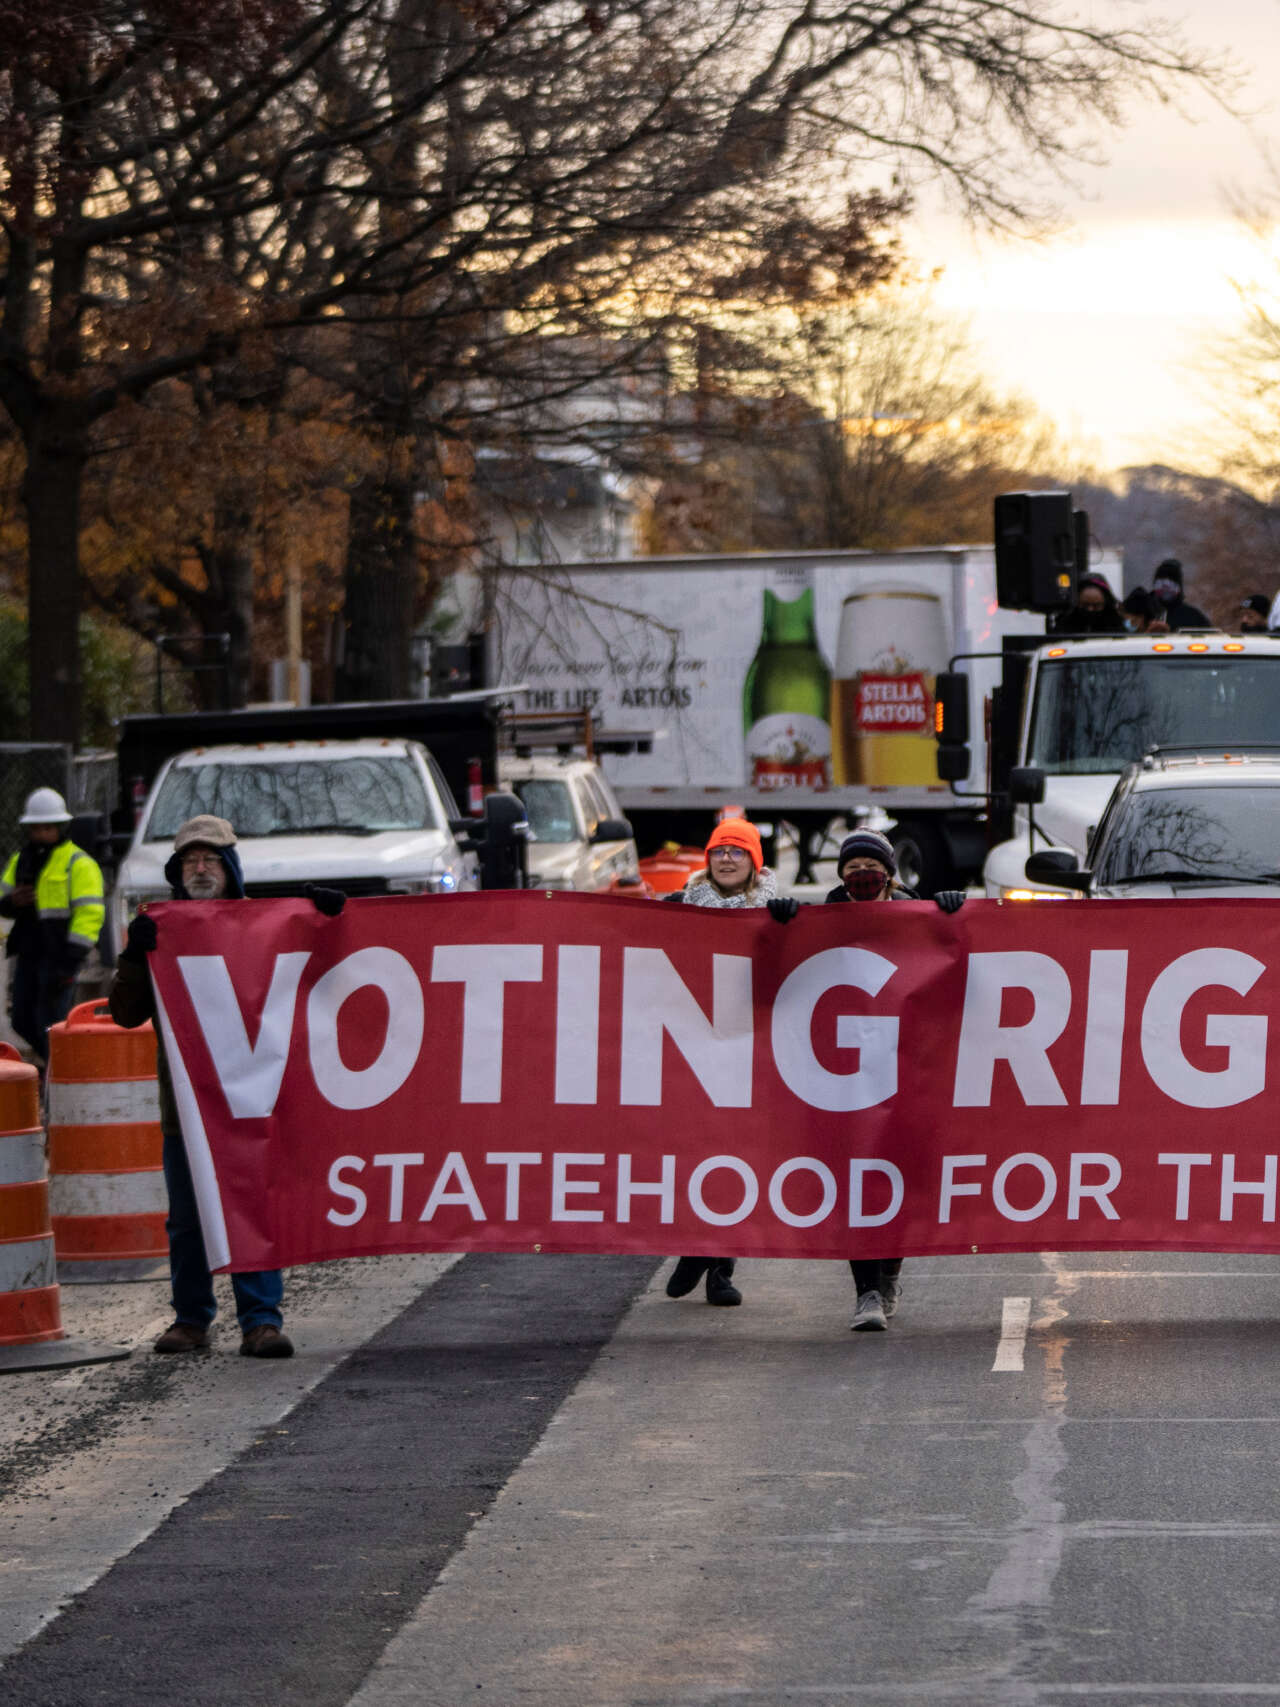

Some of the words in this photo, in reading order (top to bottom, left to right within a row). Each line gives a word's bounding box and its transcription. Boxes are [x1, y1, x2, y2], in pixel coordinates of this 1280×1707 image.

[525, 688, 558, 710] THE
[621, 685, 693, 709] ARTOIS
[862, 682, 924, 701] STELLA
[862, 703, 926, 724] ARTOIS
[177, 944, 901, 1119] VOTING
[327, 1151, 905, 1228] STATEHOOD
[938, 1152, 1123, 1224] FOR
